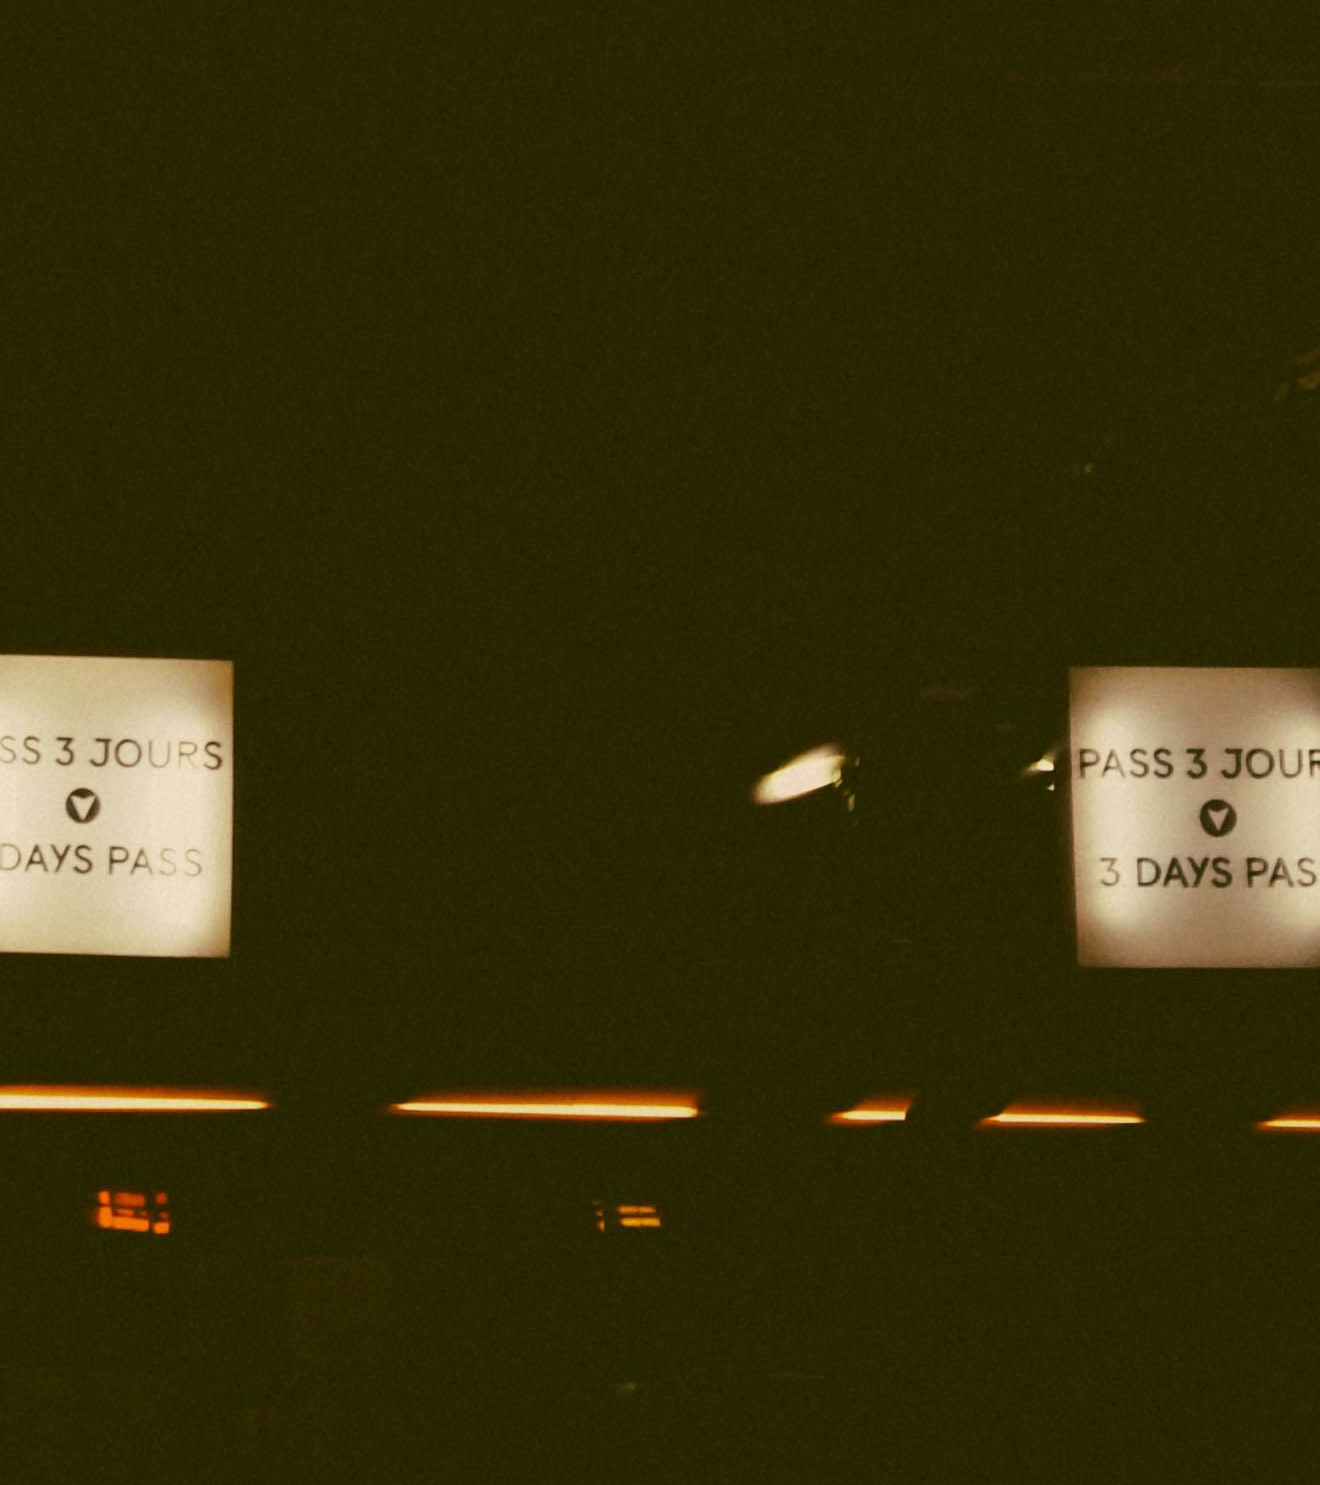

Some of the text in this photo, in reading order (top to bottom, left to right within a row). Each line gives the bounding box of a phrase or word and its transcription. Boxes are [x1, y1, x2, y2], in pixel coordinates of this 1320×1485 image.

[56, 737, 74, 766] 3
[90, 738, 223, 770] JOURS
[1077, 748, 1174, 779] PASS
[1186, 748, 1207, 778] 3
[0, 843, 93, 874] DAYS
[109, 846, 202, 877] PASS
[1100, 857, 1120, 887] 3
[1137, 857, 1233, 888] DAYS
